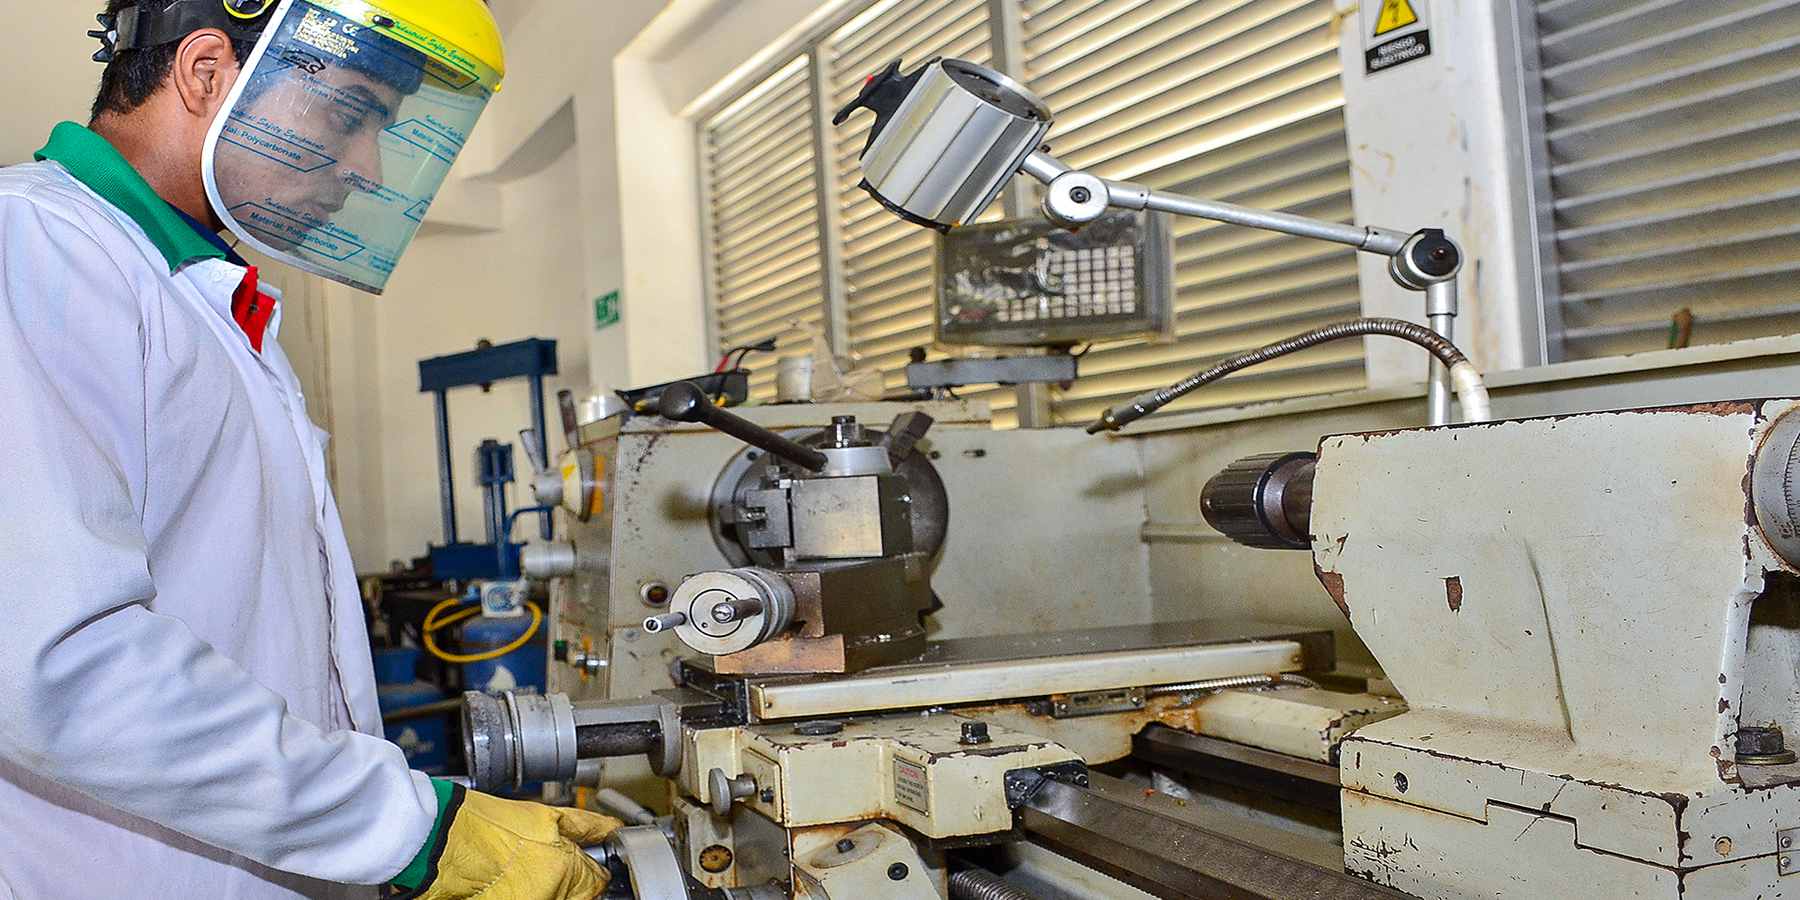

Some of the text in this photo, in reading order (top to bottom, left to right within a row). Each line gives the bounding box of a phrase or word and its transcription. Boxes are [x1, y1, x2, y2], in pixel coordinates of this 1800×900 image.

[341, 23, 360, 37] CE
[427, 38, 448, 54] Safety
[257, 117, 282, 134] Safety
[241, 130, 302, 161] Polycarbonate
[301, 212, 324, 227] Safety
[250, 211, 339, 251] Material: Polycarbonate
